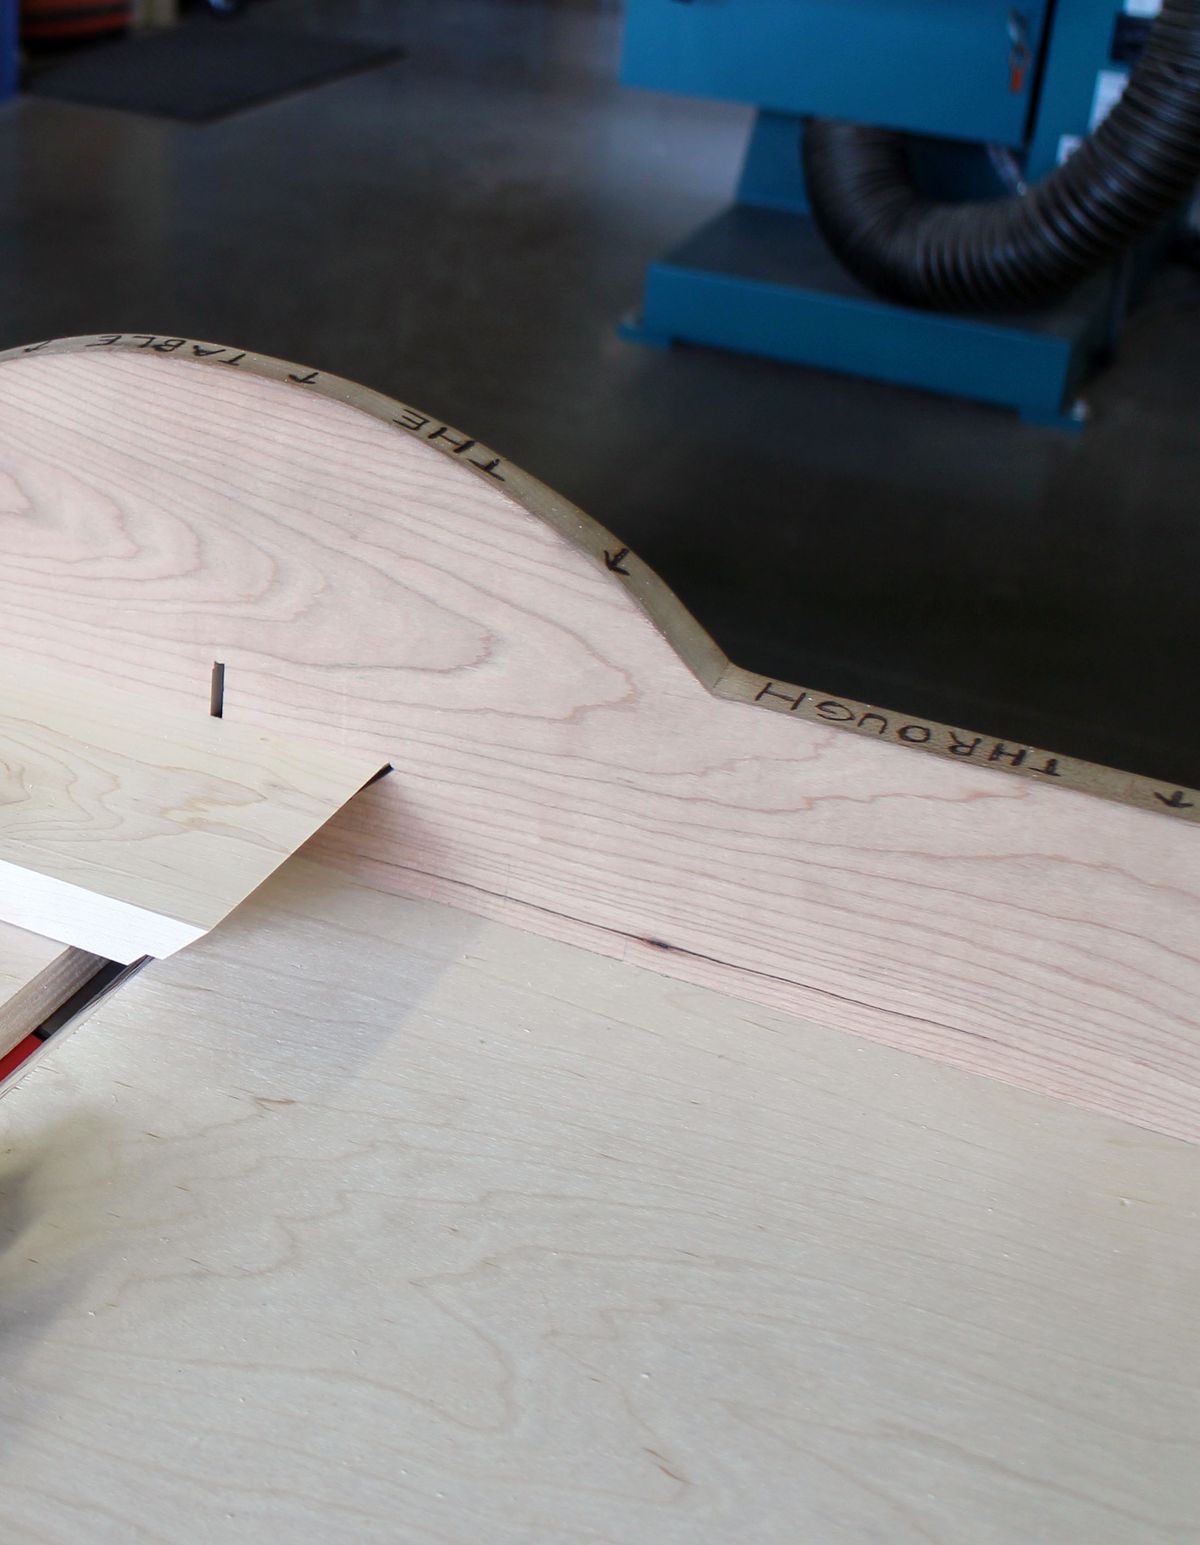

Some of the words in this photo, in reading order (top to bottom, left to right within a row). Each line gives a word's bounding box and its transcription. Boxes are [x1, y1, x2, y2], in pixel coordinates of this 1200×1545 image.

[85, 334, 247, 367] TABLE
[393, 408, 506, 482] THE
[754, 682, 1061, 777] THROUGH
